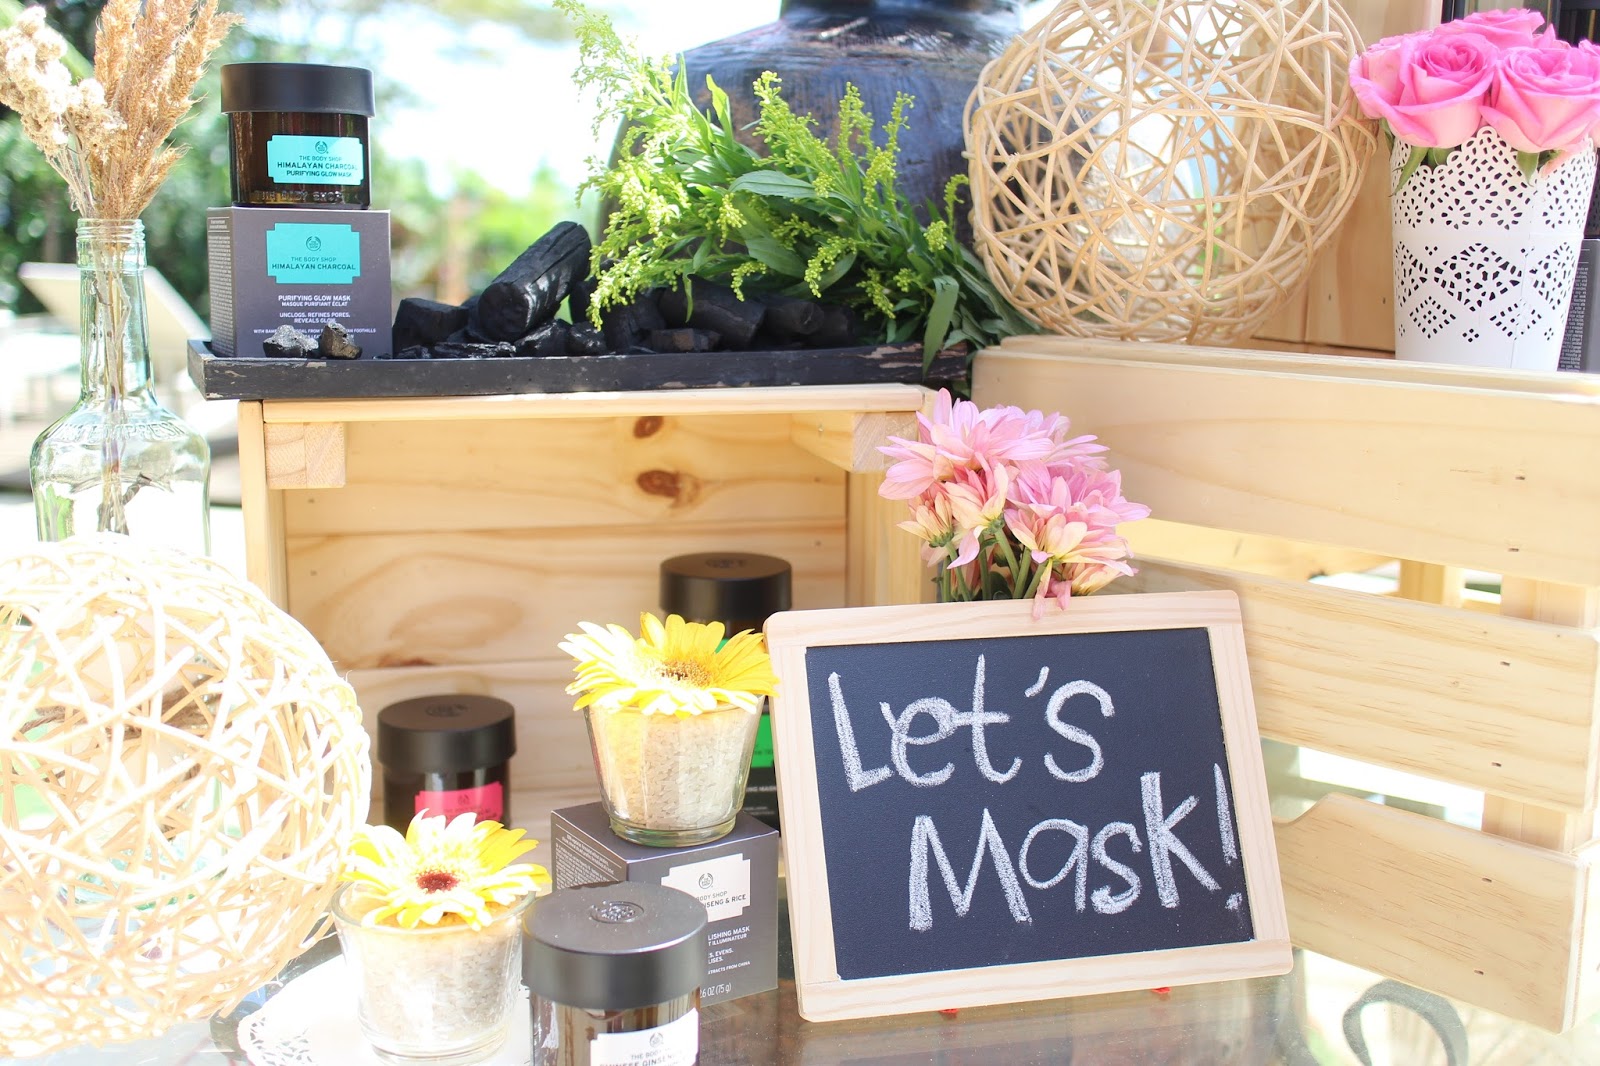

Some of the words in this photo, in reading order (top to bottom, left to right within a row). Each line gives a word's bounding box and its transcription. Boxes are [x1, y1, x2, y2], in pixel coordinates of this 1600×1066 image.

[277, 161, 323, 169] HIMALAYAN
[827, 653, 1115, 792] Let's
[908, 762, 1243, 932] Mask!
[712, 890, 728, 898] SHOP
[731, 893, 747, 902] RICE
[707, 930, 732, 941] LISHING
[732, 926, 750, 935] MASK
[712, 933, 748, 946] ILLUMINATEUR
[725, 963, 738, 971] FROM
[738, 960, 751, 968] CHINA
[707, 985, 715, 997] OZ
